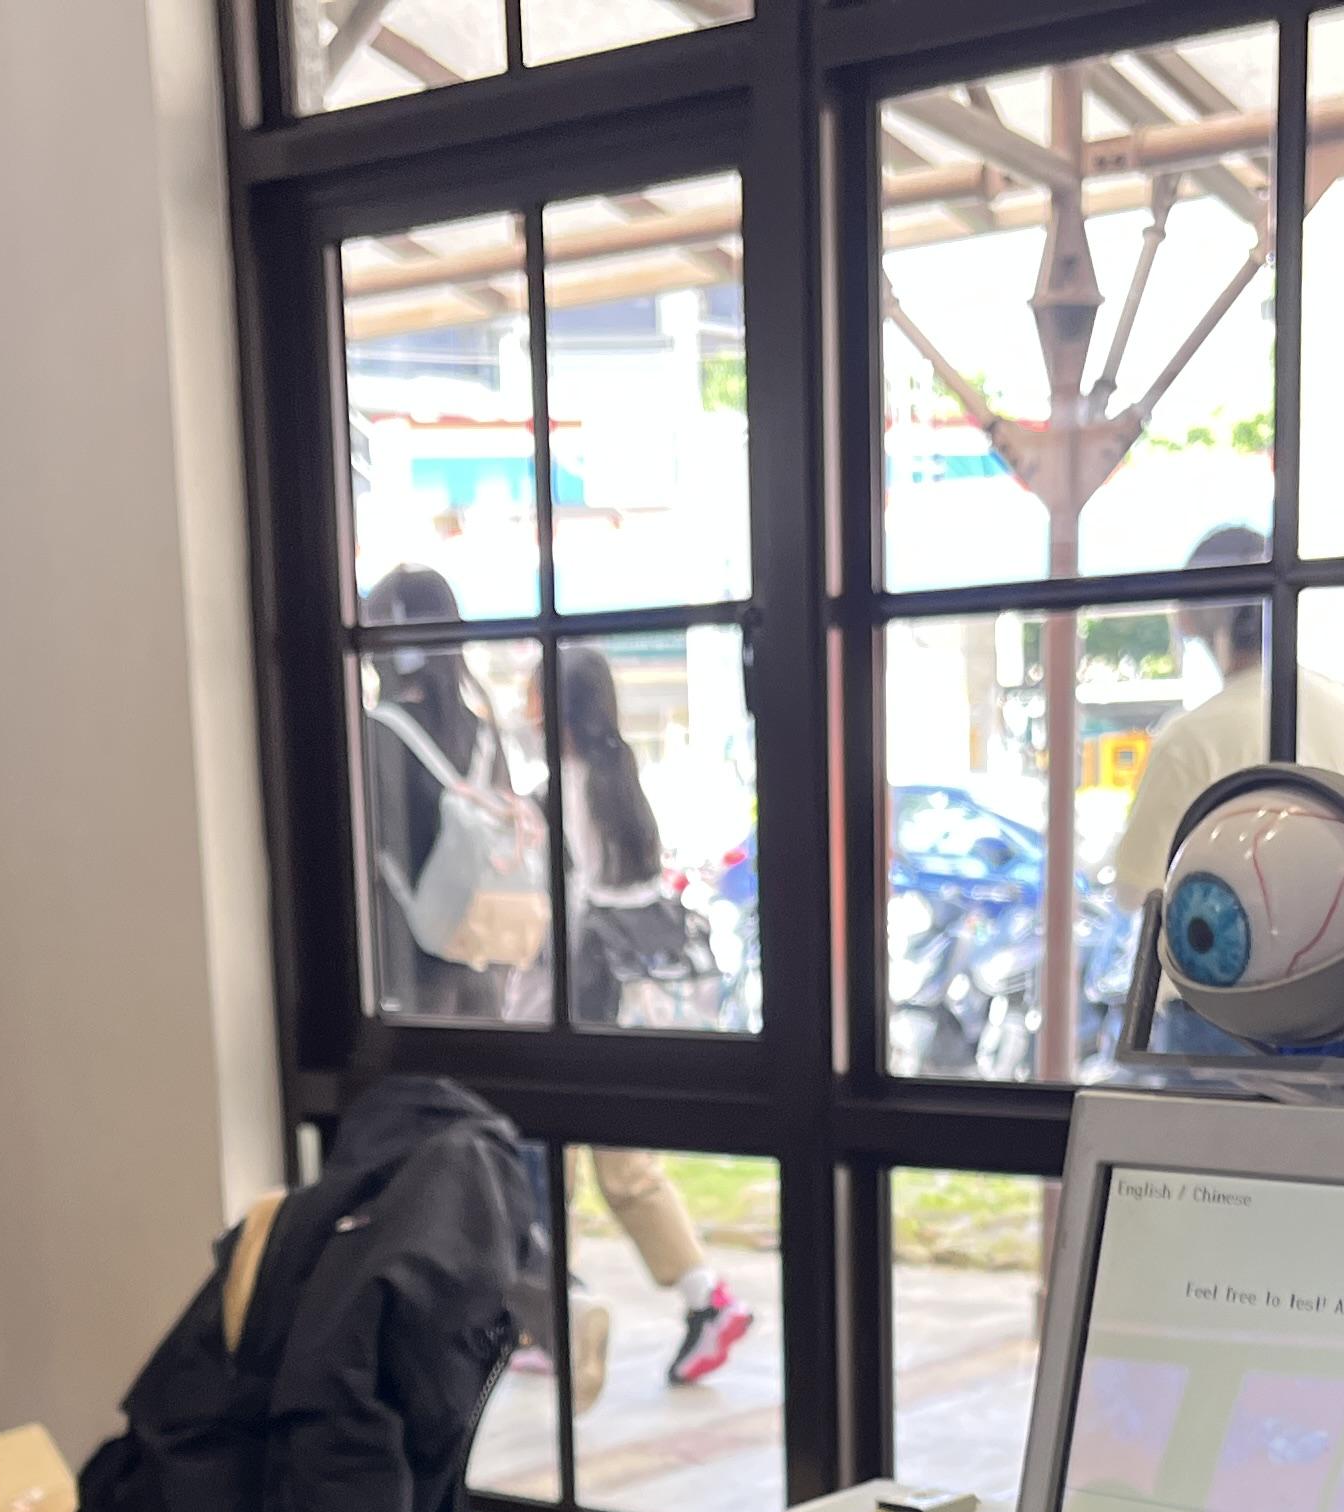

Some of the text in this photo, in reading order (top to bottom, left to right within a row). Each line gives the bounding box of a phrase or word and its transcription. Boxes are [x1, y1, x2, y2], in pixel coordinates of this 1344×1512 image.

[1117, 1180, 1171, 1201] English
[1192, 1188, 1253, 1208] Chinese
[1186, 1281, 1218, 1301] Feel
[1226, 1287, 1257, 1305] free
[1266, 1291, 1281, 1307] to
